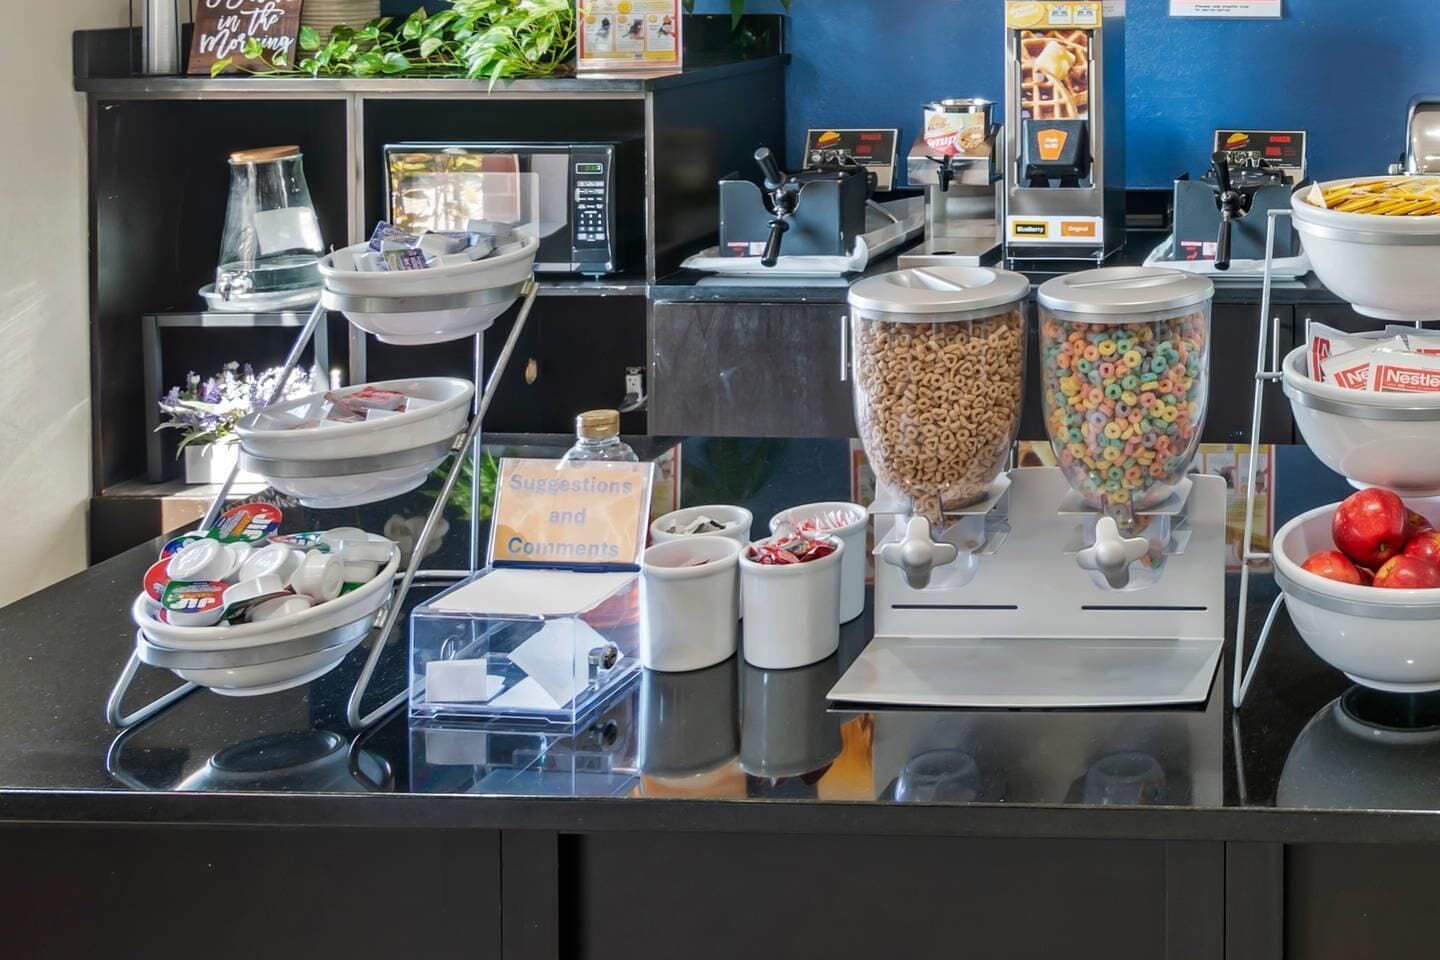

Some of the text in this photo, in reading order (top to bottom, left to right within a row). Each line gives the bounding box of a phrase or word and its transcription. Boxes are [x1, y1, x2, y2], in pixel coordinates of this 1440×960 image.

[217, 1, 285, 36] in the
[510, 474, 633, 496] Suggestions
[549, 507, 587, 525] and
[507, 537, 619, 558] Comments
